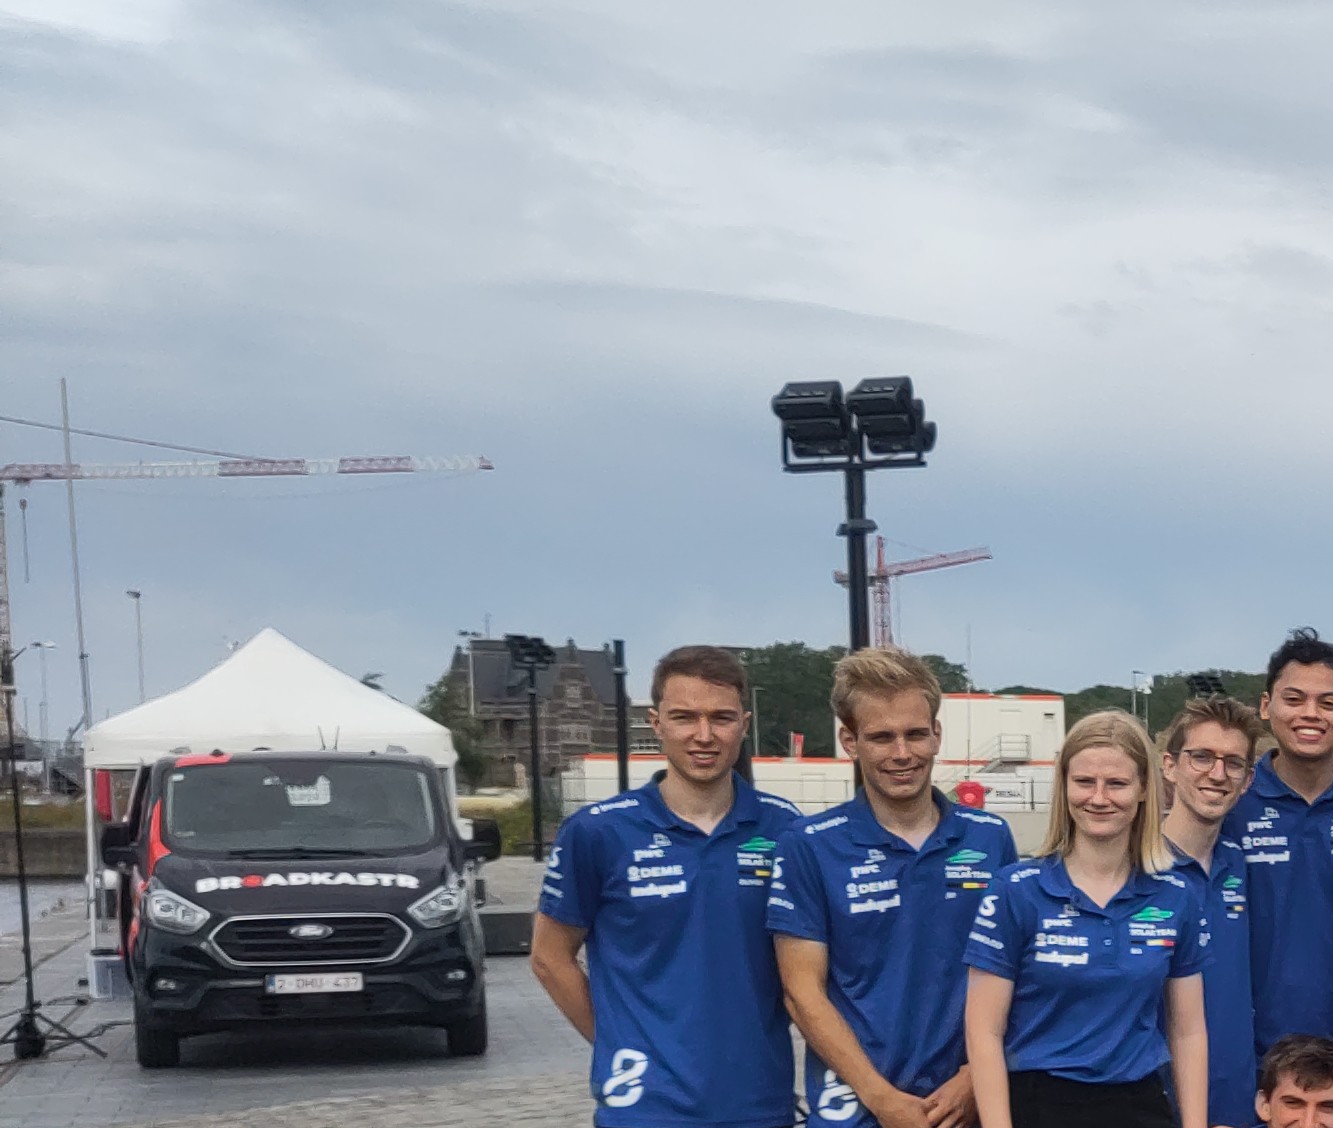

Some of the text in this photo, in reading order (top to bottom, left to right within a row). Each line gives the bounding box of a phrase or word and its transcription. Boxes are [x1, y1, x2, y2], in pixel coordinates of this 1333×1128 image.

[1252, 836, 1288, 846] DEME
[640, 865, 684, 878] DEME
[1047, 936, 1089, 946] DEME
